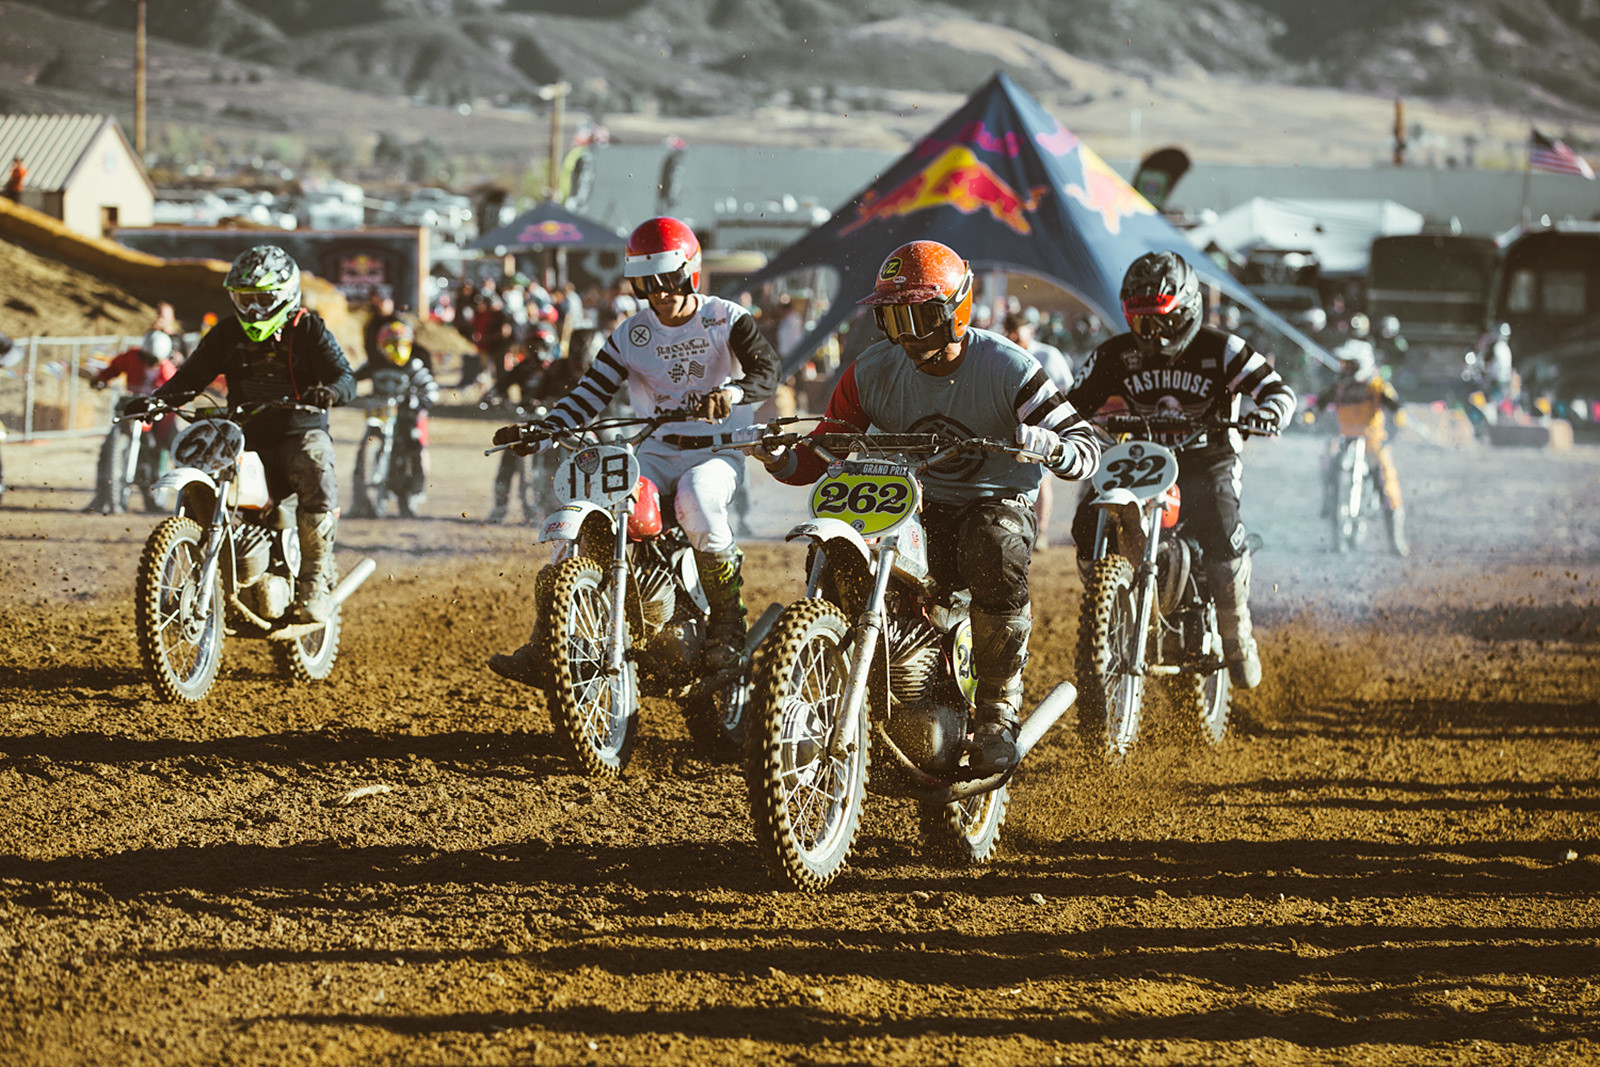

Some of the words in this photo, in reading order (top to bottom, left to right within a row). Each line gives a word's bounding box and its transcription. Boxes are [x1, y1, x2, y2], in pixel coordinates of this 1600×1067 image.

[1123, 369, 1213, 398] FASTHOUSE
[863, 463, 889, 475] GRAND
[889, 466, 908, 476] PRIX
[1102, 455, 1167, 491] 32
[816, 481, 909, 515] 262
